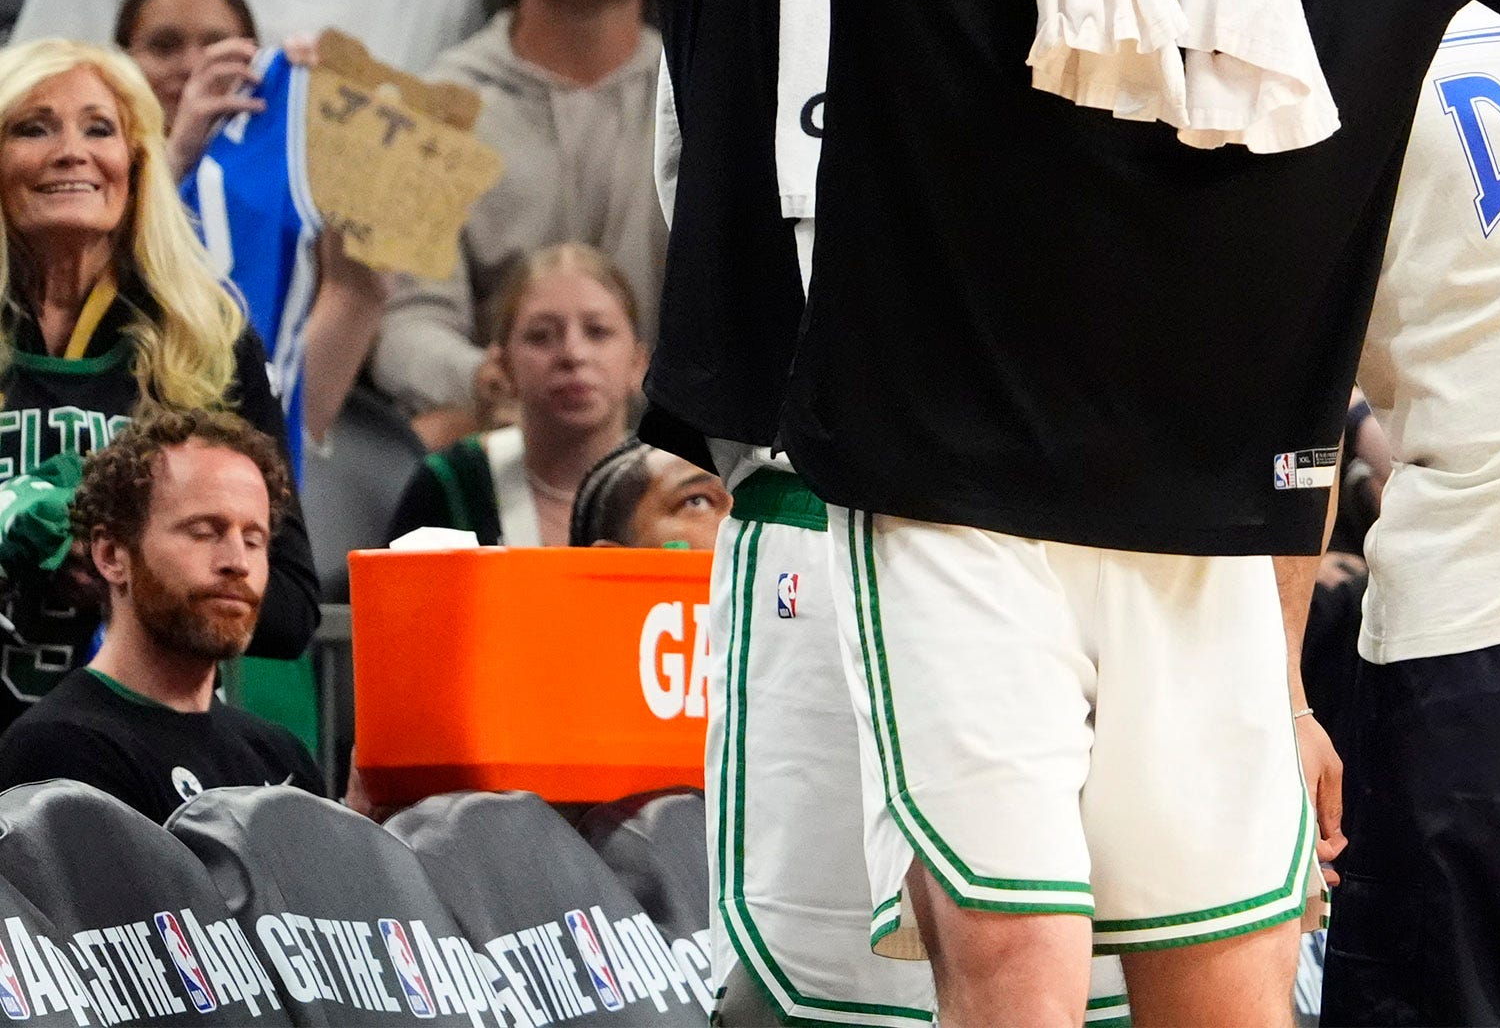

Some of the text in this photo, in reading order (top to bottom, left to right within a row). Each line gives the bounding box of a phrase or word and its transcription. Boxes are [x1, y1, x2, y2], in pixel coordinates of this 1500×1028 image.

[102, 921, 187, 1018] THE
[256, 912, 344, 1003] GET
[314, 918, 402, 1012] THE
[517, 921, 597, 1020] THE
